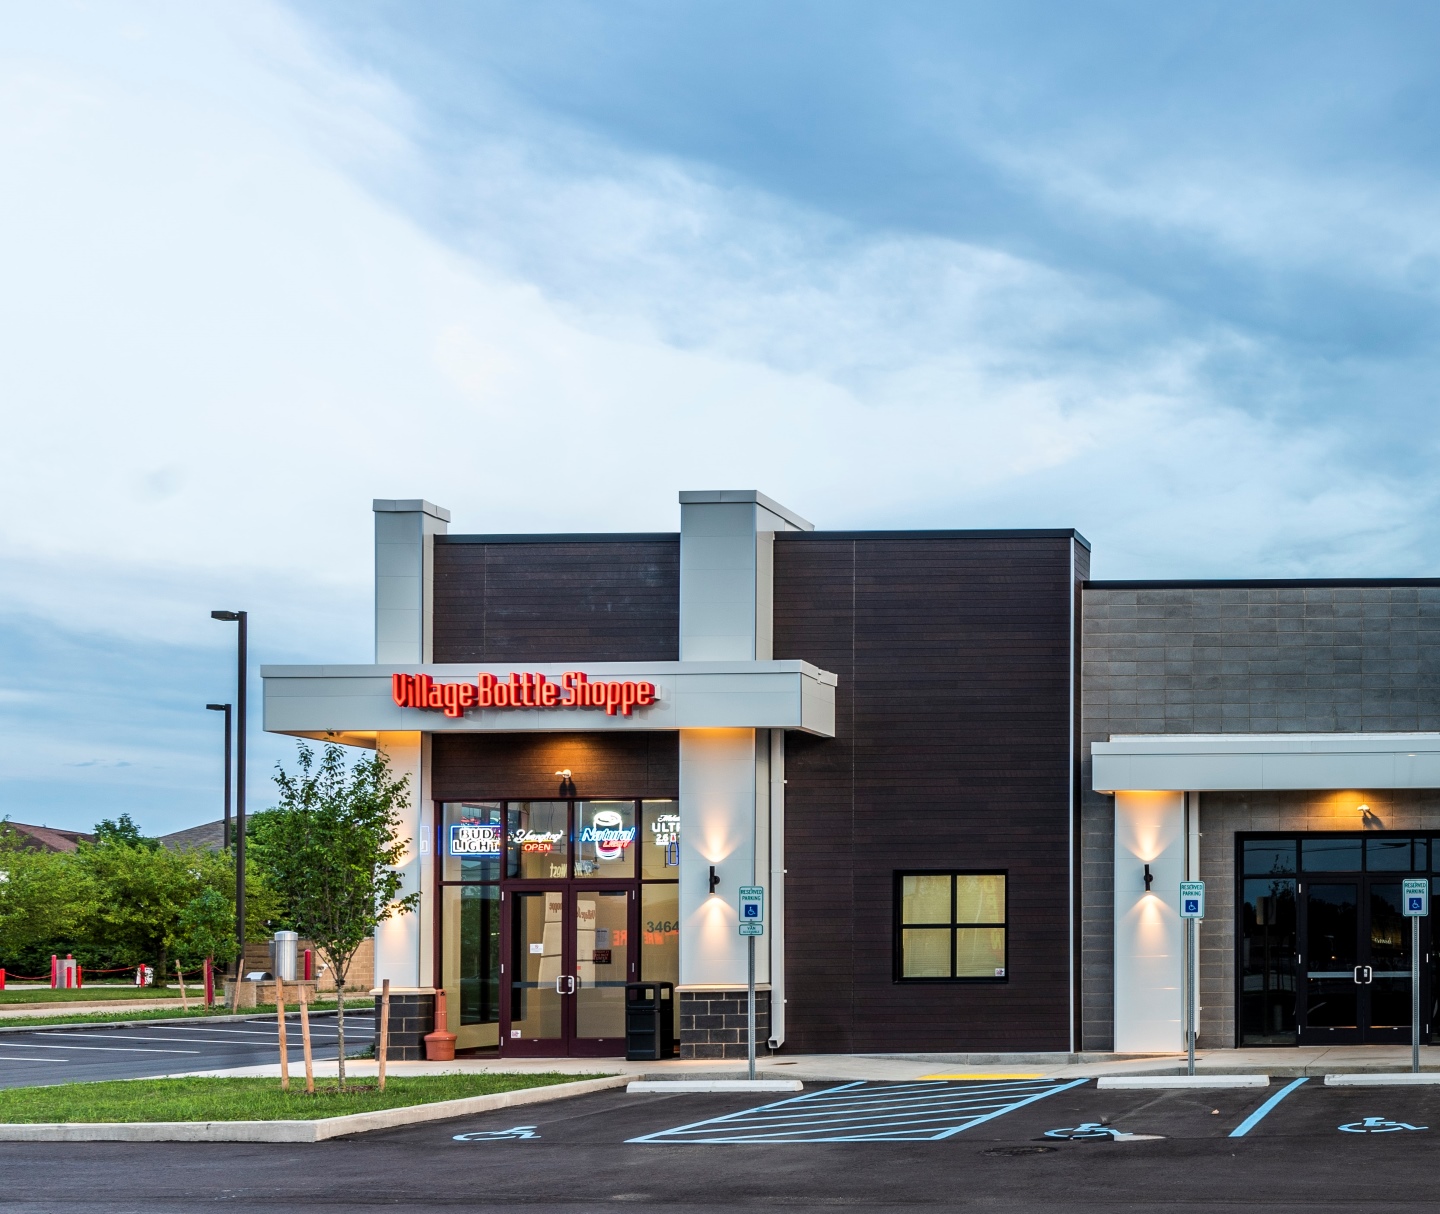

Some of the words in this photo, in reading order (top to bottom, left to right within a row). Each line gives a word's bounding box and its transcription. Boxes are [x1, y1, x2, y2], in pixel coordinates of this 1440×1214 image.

[392, 673, 477, 718] Village
[478, 672, 561, 708] Bottle
[562, 671, 657, 716] Shoppe
[459, 827, 494, 841] BUD
[581, 827, 636, 842] Natural
[651, 822, 680, 833] ULT
[452, 839, 500, 853] LIGHT
[524, 843, 552, 852] OPEN
[646, 920, 679, 933] 3464
